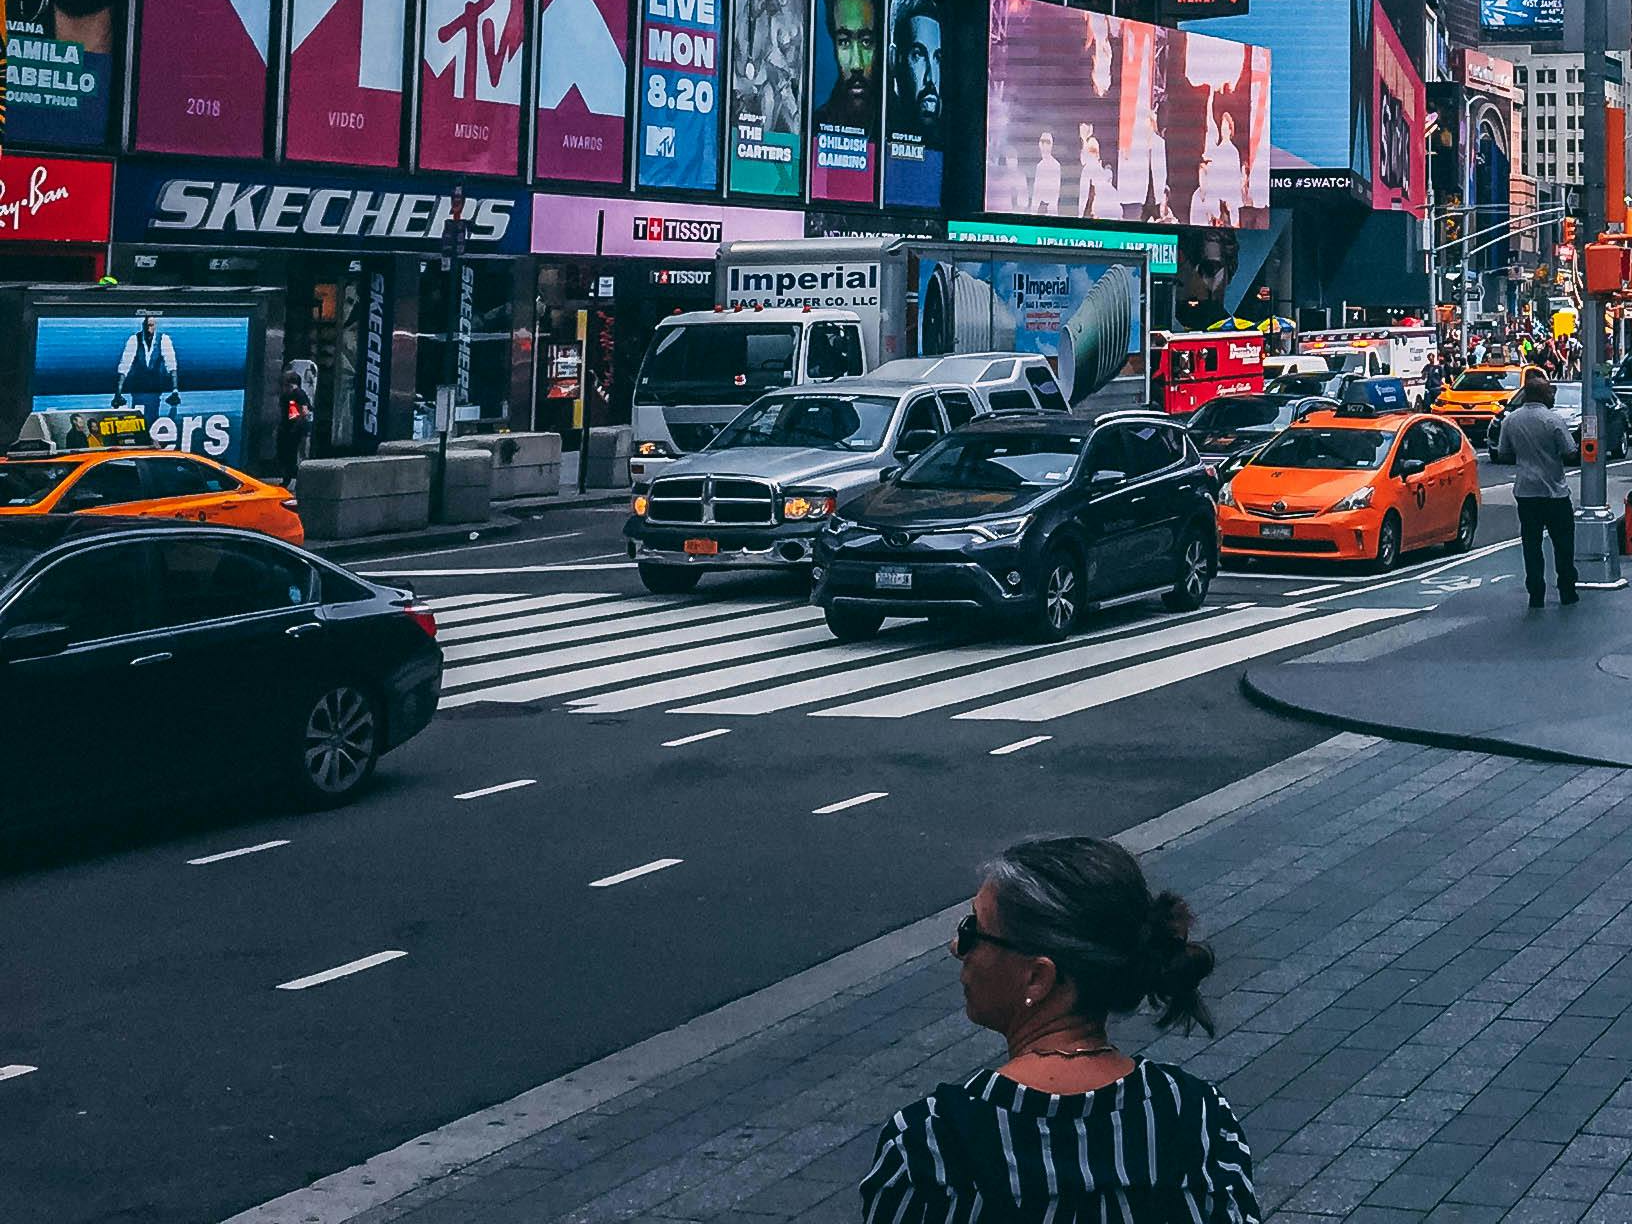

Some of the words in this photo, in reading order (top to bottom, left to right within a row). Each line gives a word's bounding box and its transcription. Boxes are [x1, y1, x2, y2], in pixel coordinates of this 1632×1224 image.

[6, 38, 80, 65] AMILA
[648, 28, 715, 69] MON
[6, 65, 95, 93] ABELLO
[5, 90, 42, 104] OUNG
[44, 94, 78, 107] THUG
[647, 74, 714, 114] 8.20
[187, 98, 221, 117] 2018
[328, 110, 365, 130] VIDEO
[454, 122, 489, 141] MUSIC
[739, 125, 762, 141] THE
[562, 133, 603, 152] AWARDS
[818, 135, 867, 153] CHILDISH
[891, 143, 924, 159] DRAKE
[738, 143, 792, 162] CARTERS
[818, 151, 867, 170] GAMBINO
[1271, 177, 1292, 188] ING
[1295, 177, 1353, 188] #SWATCH
[151, 178, 514, 241] SKECHERS
[665, 221, 721, 241] TISSOT
[669, 269, 711, 284] TISSOT
[730, 265, 877, 296] Imperial
[1026, 276, 1069, 300] Imperial
[777, 296, 821, 308] PAPER
[825, 295, 848, 307] CO.
[852, 295, 877, 306] LLC
[363, 272, 385, 437] SKECHERS
